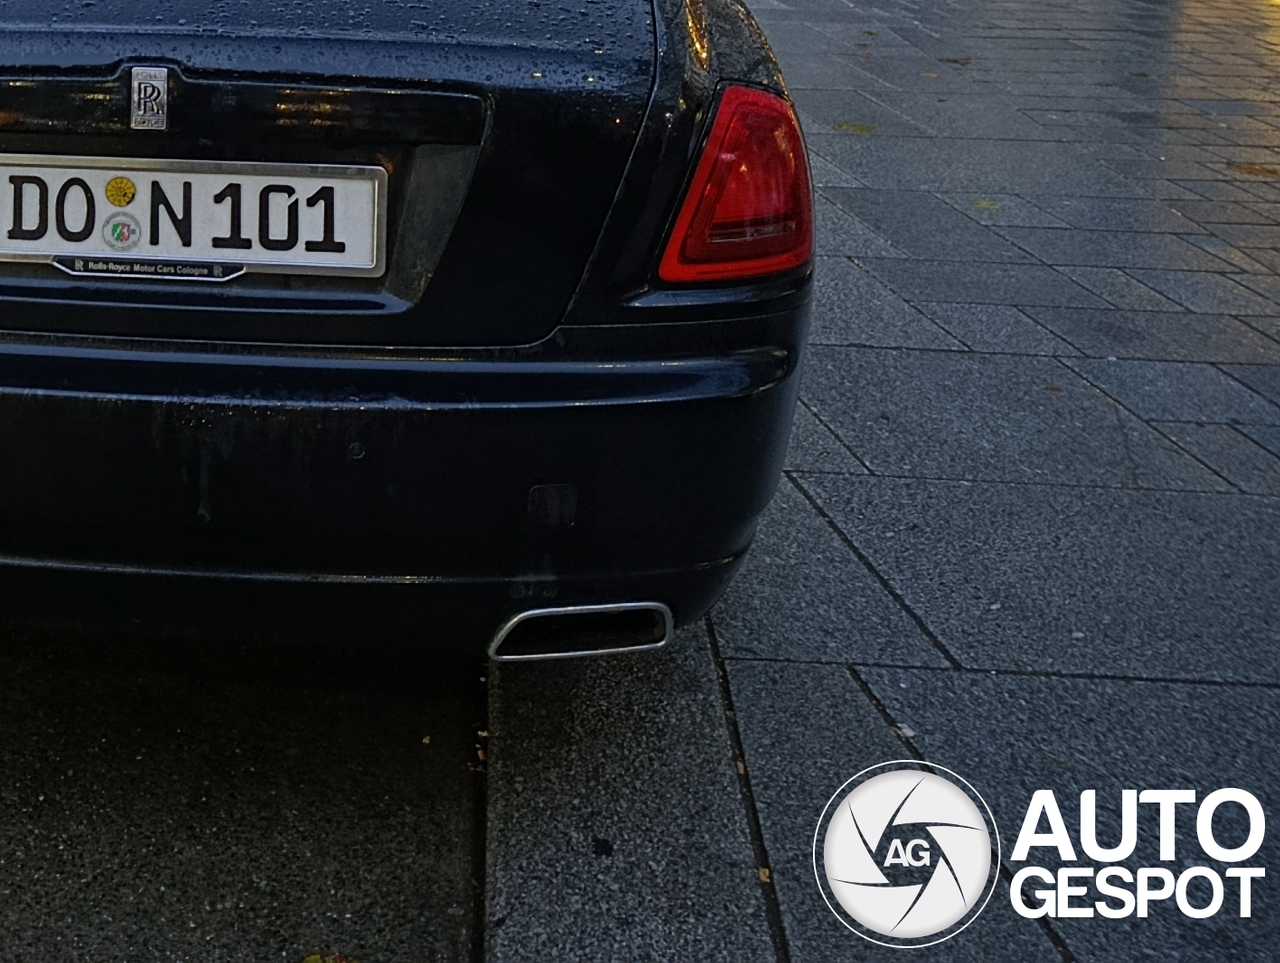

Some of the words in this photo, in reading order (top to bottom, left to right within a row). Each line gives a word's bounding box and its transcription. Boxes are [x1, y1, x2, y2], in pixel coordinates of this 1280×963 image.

[135, 71, 163, 79] ROLLS
[7, 175, 96, 242] DO
[149, 180, 192, 247] N
[212, 183, 346, 253] 101
[88, 261, 131, 273] Rolls-Royce
[133, 263, 155, 273] Motor
[157, 264, 175, 274] Cars
[176, 265, 208, 276] Cologne
